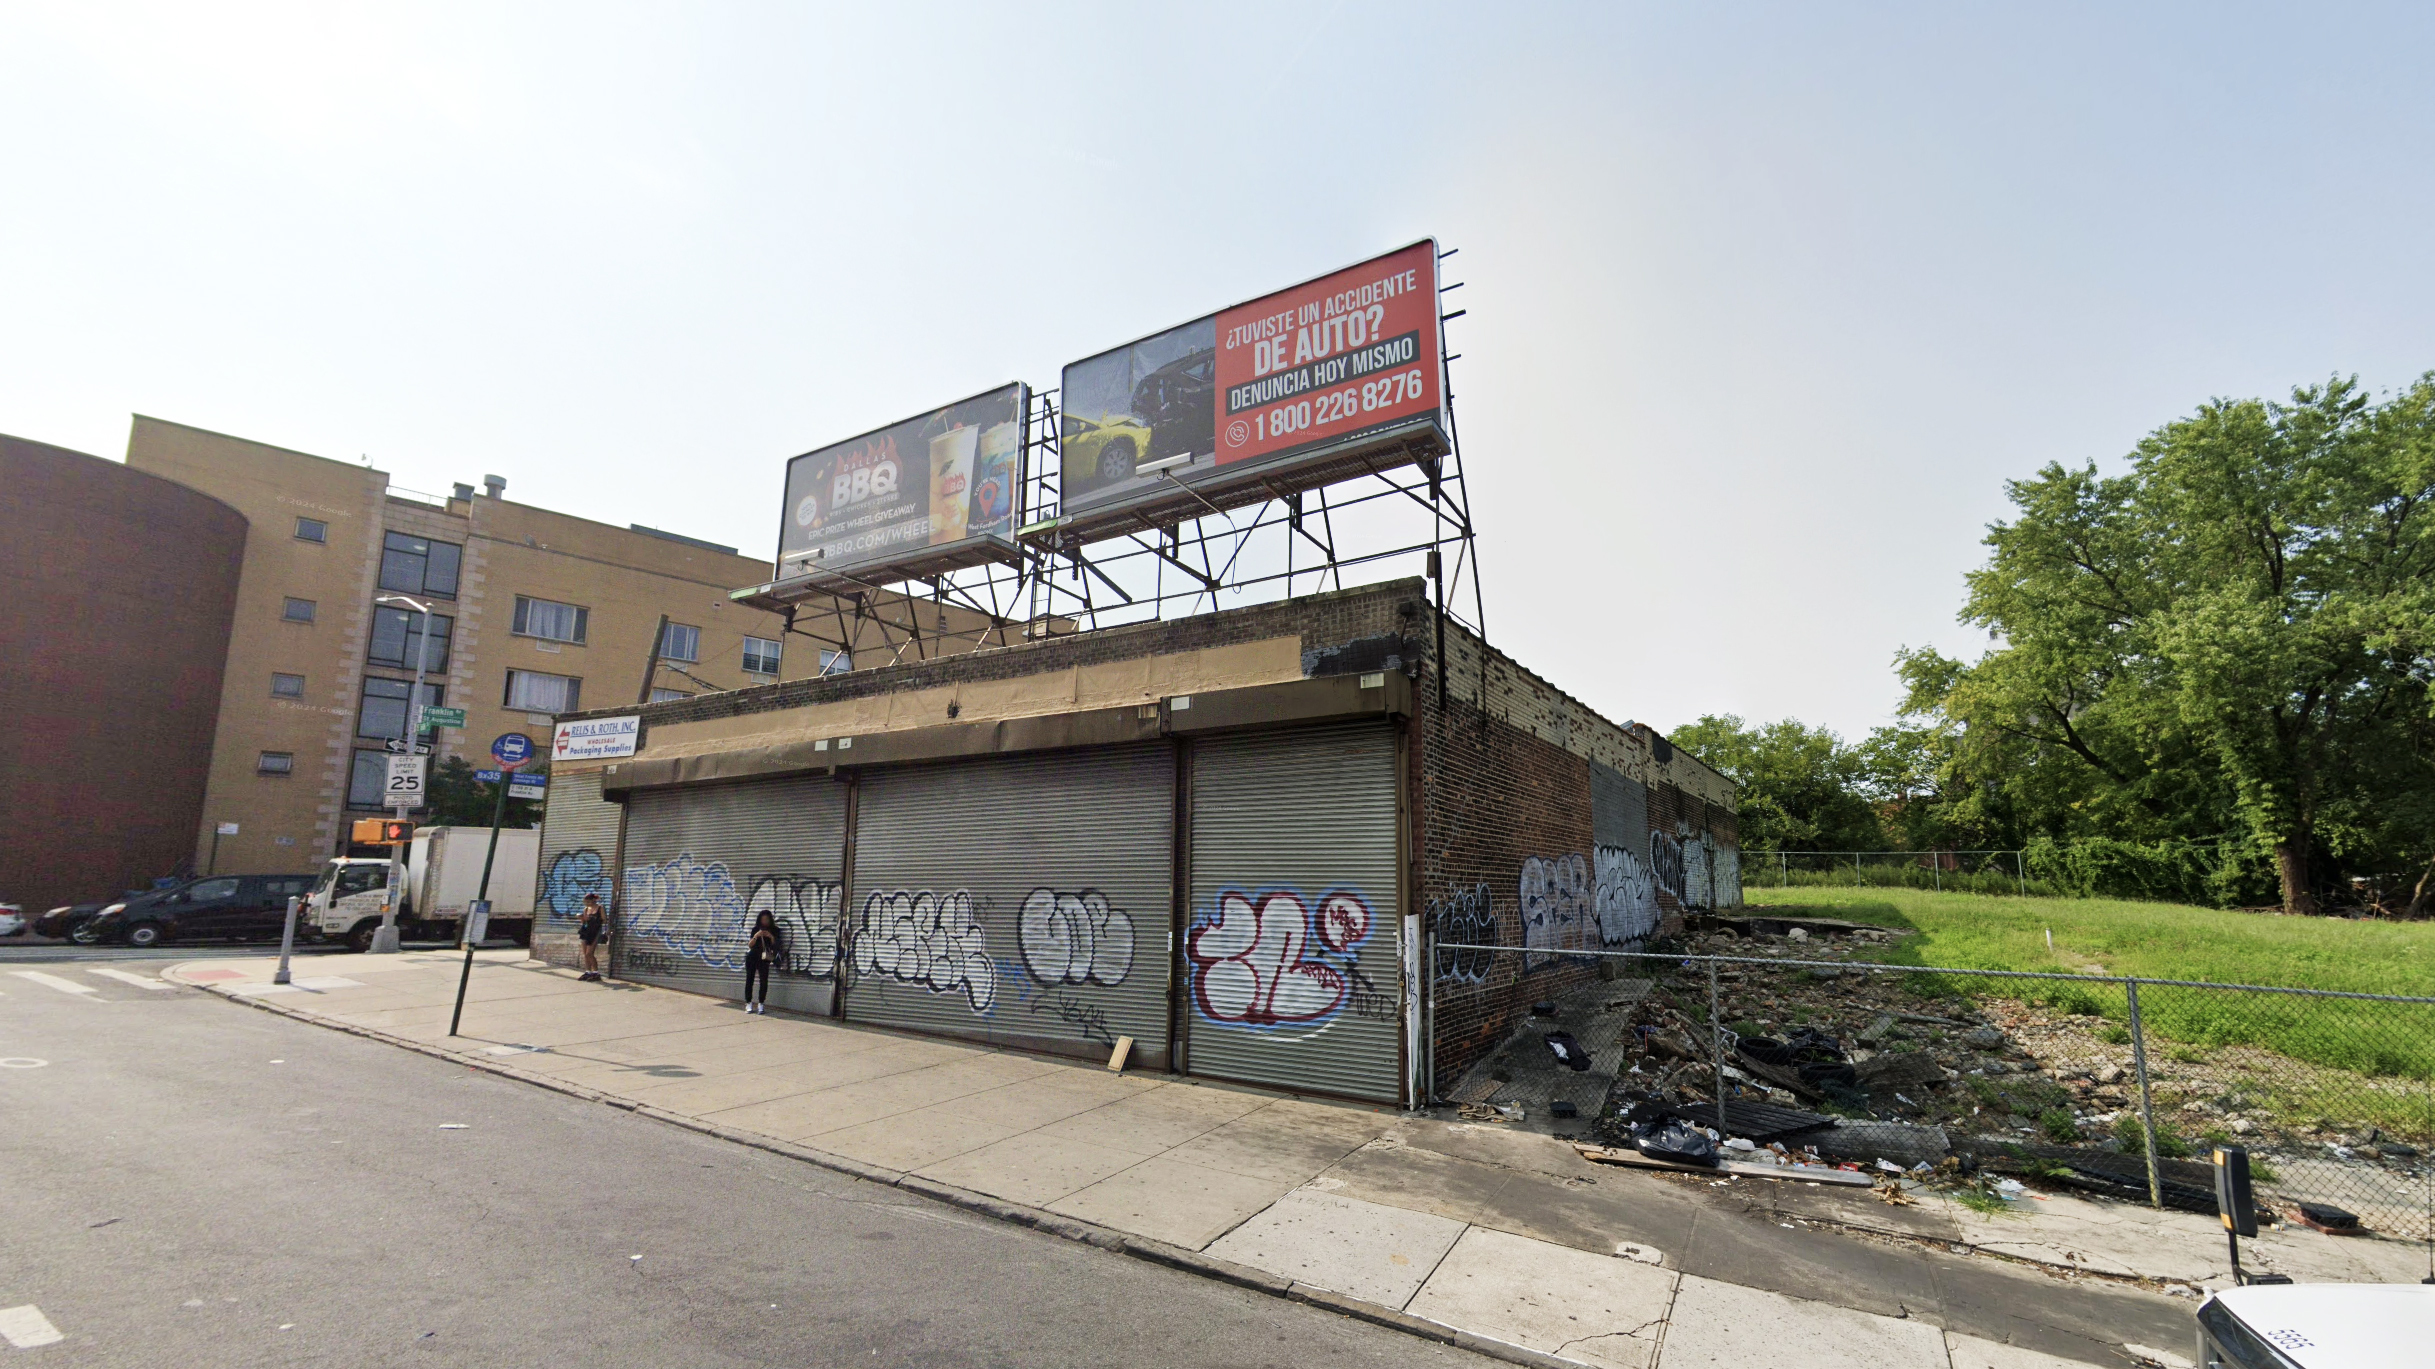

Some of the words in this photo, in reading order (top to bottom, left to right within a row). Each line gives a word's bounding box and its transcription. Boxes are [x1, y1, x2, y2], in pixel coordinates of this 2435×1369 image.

[1226, 310, 1294, 350] ¿TUVISTE
[1298, 300, 1320, 326] UN
[1324, 269, 1416, 319] ACCIDENTE
[1254, 333, 1288, 377] DE
[1294, 304, 1385, 365] AUTO?
[1231, 369, 1310, 411] DENUNCIA
[1314, 357, 1347, 386] HOY
[1352, 337, 1413, 376] MISMO
[1255, 413, 1264, 441] 1
[1270, 401, 1311, 437] 800
[1315, 387, 1358, 425] 226
[1362, 369, 1423, 412] 8276
[843, 451, 886, 472] DALLAS
[831, 460, 898, 510] BBQ
[808, 528, 825, 540] EPIC
[825, 521, 846, 536] PRIZE
[846, 515, 874, 530] WHEEL
[874, 502, 917, 522] GIVEAWAY
[424, 706, 454, 716] Franklin
[571, 724, 589, 736] RELIS
[590, 724, 596, 735] &
[621, 721, 636, 732] INC.
[569, 745, 602, 756] Packaging
[604, 743, 631, 754] Supplies
[587, 737, 616, 745] WHOLESALE
[391, 776, 419, 790] 25
[477, 771, 501, 781] Bx35
